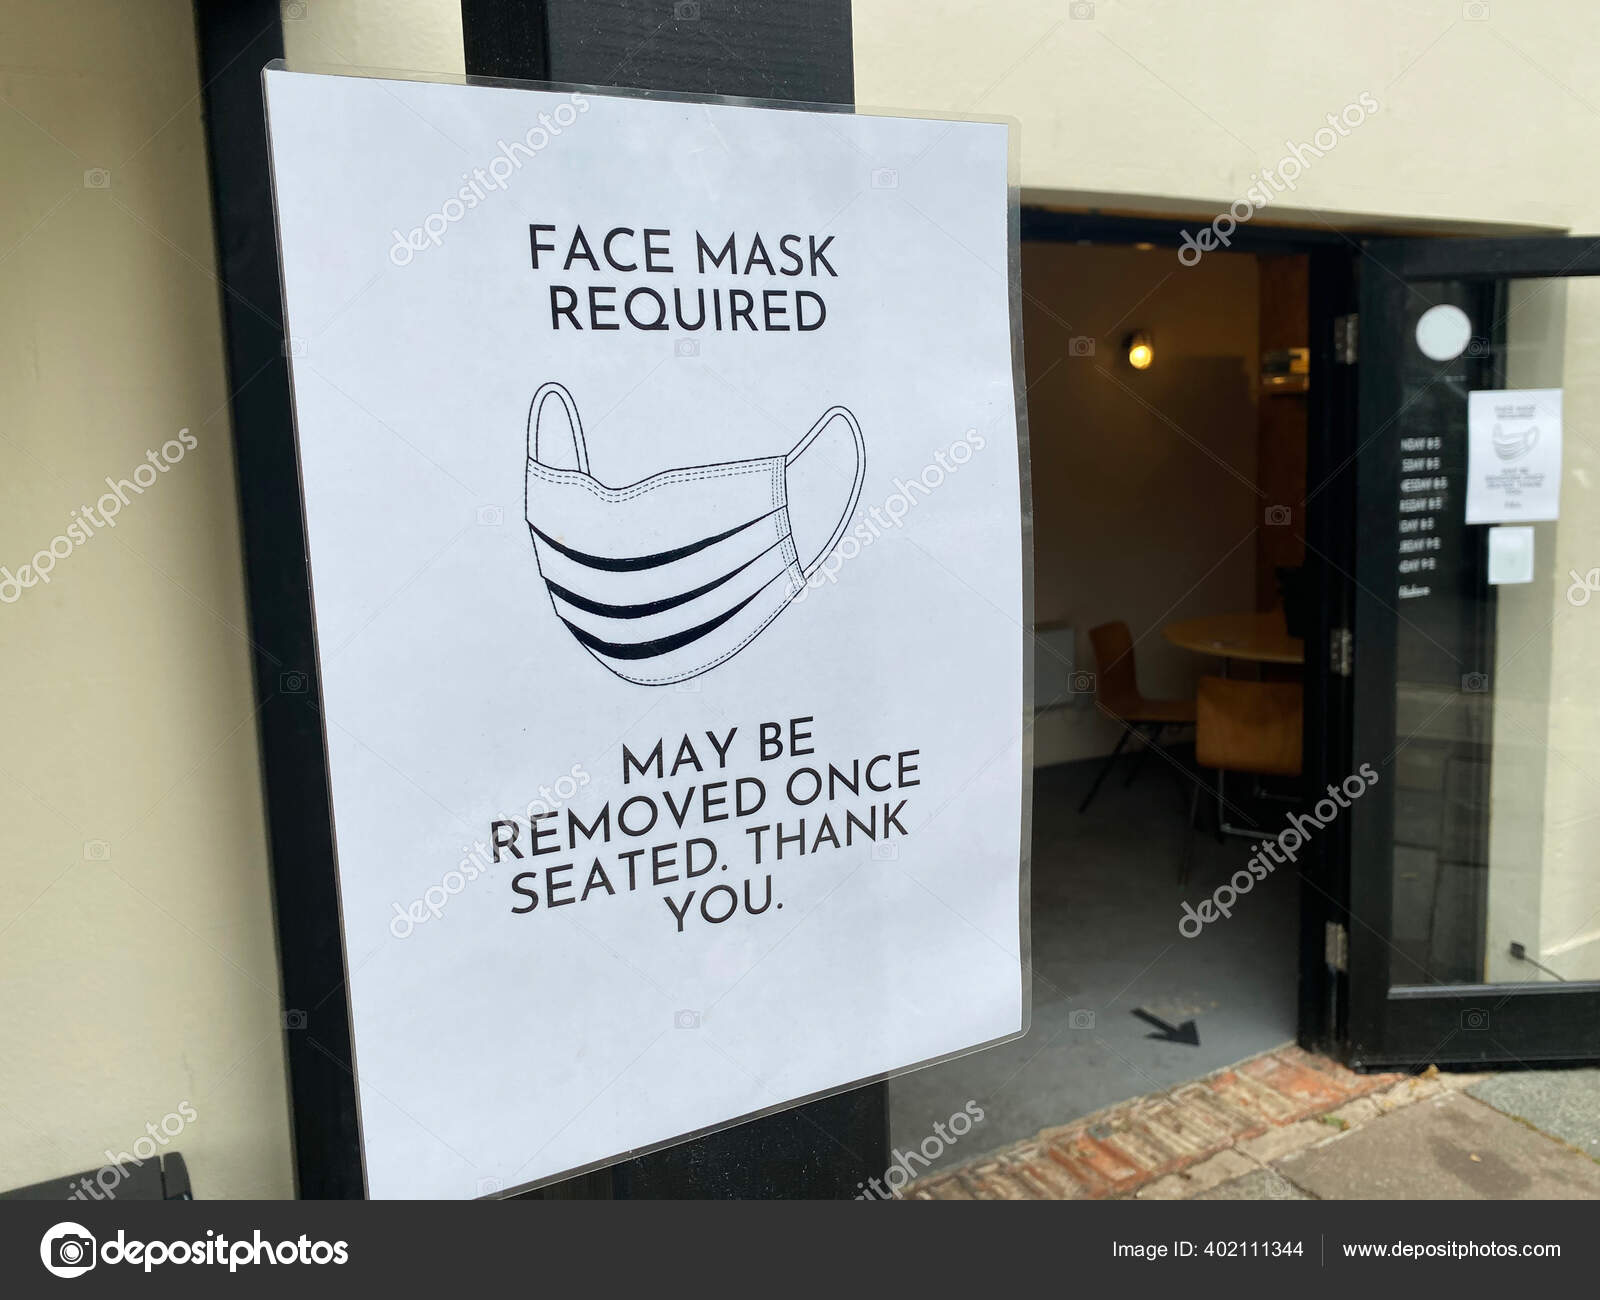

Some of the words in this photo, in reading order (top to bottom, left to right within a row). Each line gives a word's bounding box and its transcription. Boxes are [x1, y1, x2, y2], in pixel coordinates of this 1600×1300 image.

[529, 223, 674, 273] FACE
[695, 230, 839, 277] MASK
[550, 286, 827, 332] REQUIRED
[622, 727, 738, 785] MAY
[759, 717, 815, 762] BE
[491, 777, 767, 864] REMOVED
[786, 750, 921, 806] ONCE
[511, 837, 728, 914] SEATED.
[745, 800, 909, 865] THANK
[663, 875, 783, 933] YOU.
